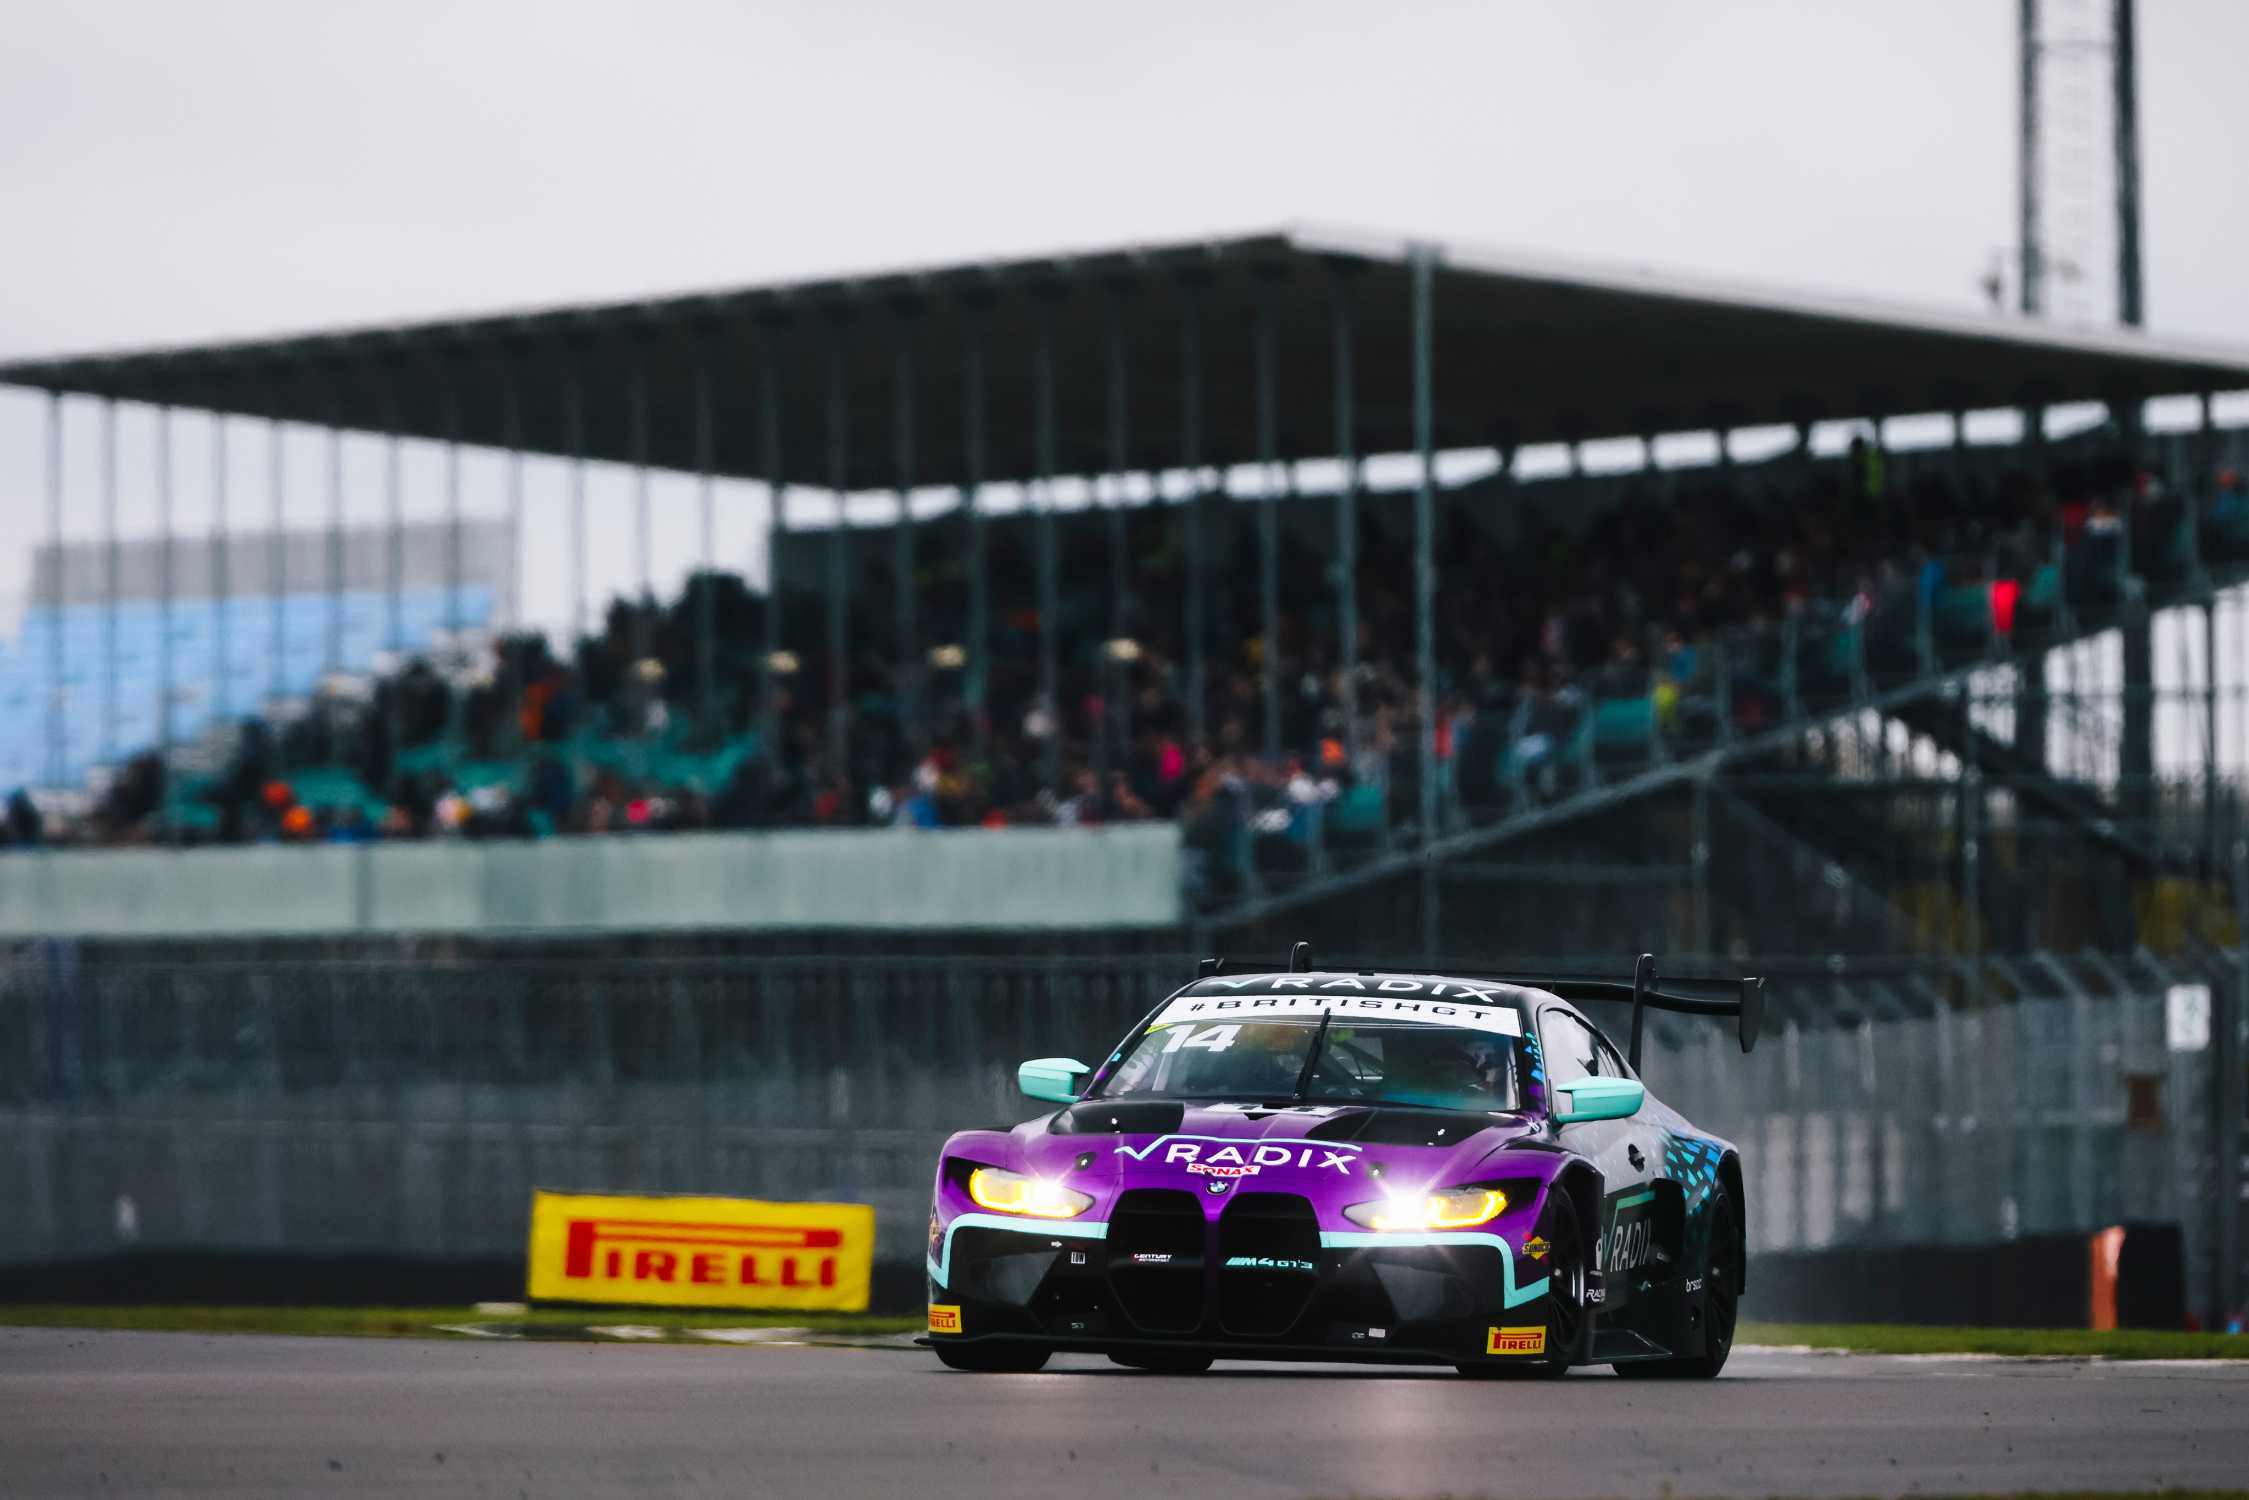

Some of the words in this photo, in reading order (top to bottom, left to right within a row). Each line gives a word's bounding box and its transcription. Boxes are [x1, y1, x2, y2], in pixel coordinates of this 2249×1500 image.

[1270, 976, 1502, 1003] RADIX
[1189, 998, 1492, 1020] #BRITISHGT
[1161, 1024, 1242, 1052] 14
[1164, 1143, 1357, 1175] RADIX
[1188, 1164, 1256, 1176] SONAX
[565, 1219, 843, 1288] PIRELLI
[1493, 1332, 1542, 1350] PIRELLI
